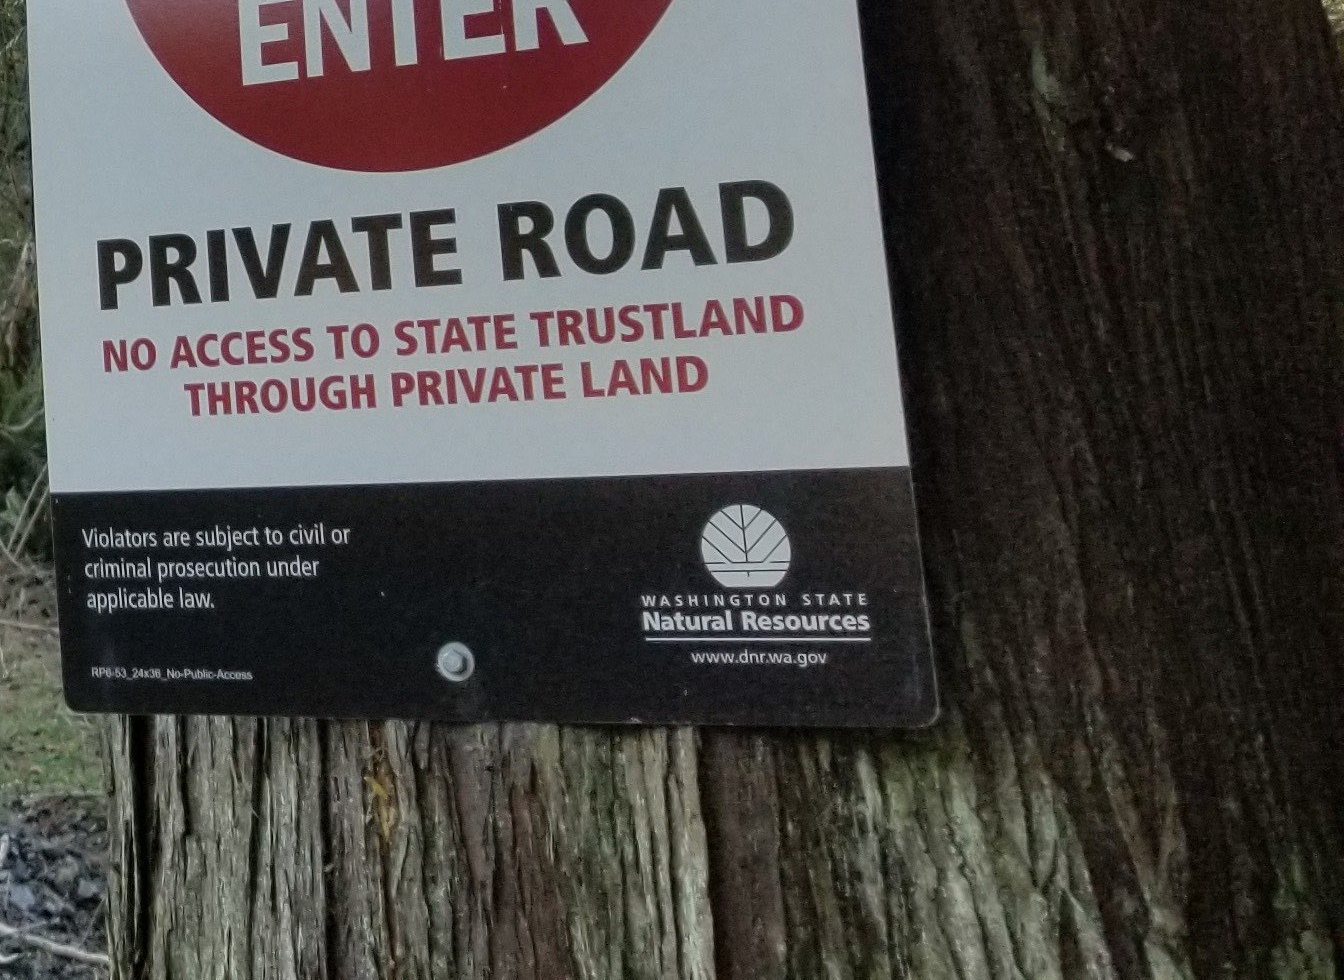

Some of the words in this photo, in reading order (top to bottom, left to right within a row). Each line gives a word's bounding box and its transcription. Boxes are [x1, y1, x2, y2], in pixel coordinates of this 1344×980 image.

[96, 207, 462, 310] PRIVATE
[497, 179, 795, 282] ROAD
[102, 338, 157, 373] NO
[169, 328, 314, 370] ACCESS
[327, 322, 380, 360] TO
[395, 313, 519, 356] STATE
[529, 294, 805, 348] TRUSTLAND
[184, 374, 378, 416] THROUGH
[392, 363, 567, 408] PRIVATE
[581, 355, 709, 398] LAND
[81, 527, 157, 548] Violators
[162, 531, 190, 546] are
[195, 525, 260, 551] subject
[264, 527, 283, 545] to
[289, 523, 326, 545] civil
[331, 528, 351, 544] or
[84, 557, 152, 578] criminal
[157, 557, 261, 582] prosecution
[266, 555, 319, 577] under
[86, 588, 174, 613] applicable
[179, 587, 215, 609] law.
[640, 594, 787, 607] WASHINGTON
[802, 593, 868, 606] STATE
[642, 610, 733, 631] Natural
[741, 611, 871, 631] Resources
[691, 649, 827, 667] www.dnr.wa.gov
